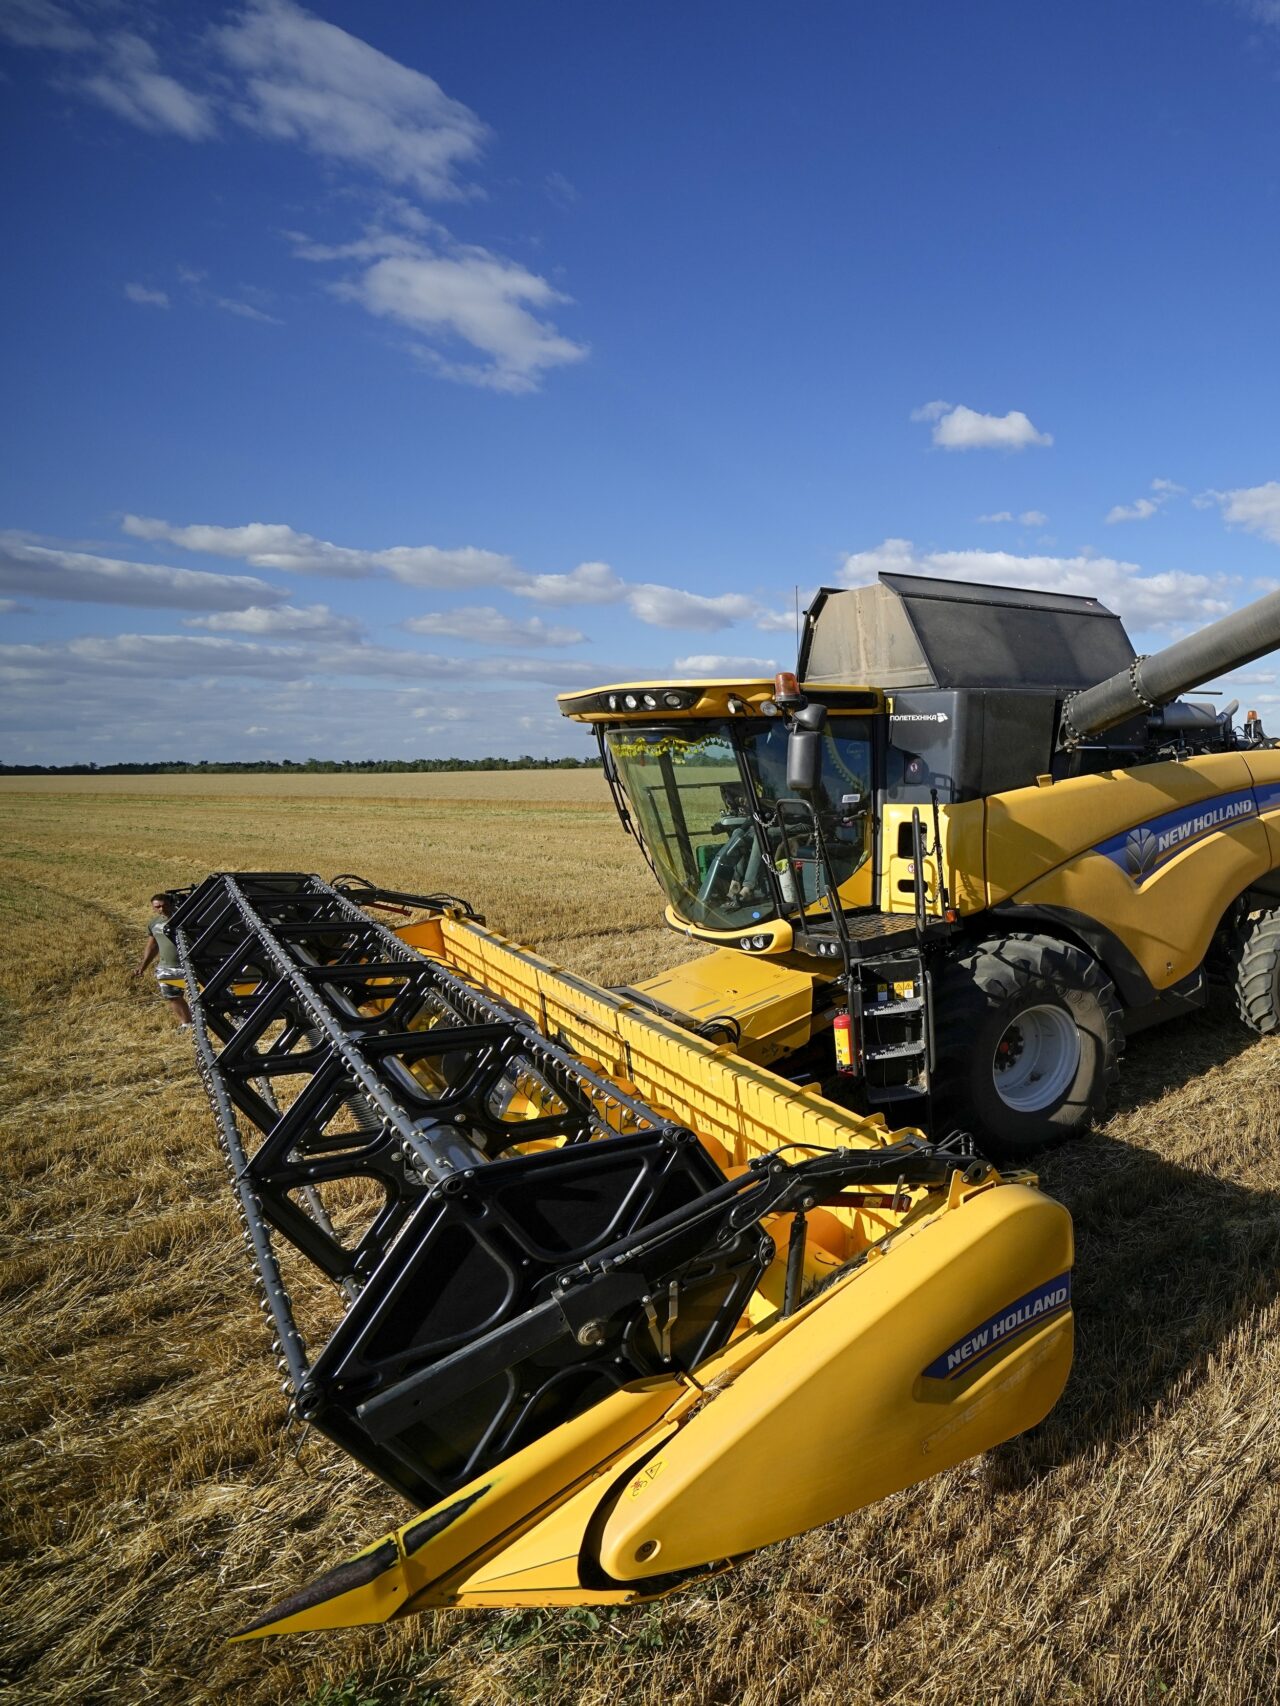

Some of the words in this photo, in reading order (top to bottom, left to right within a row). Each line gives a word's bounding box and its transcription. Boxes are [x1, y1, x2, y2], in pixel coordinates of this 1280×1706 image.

[1158, 823, 1192, 852] NEW
[1194, 799, 1252, 833] HOLLAND
[947, 1330, 989, 1371] NEW
[992, 1287, 1067, 1338] HOLLAND
